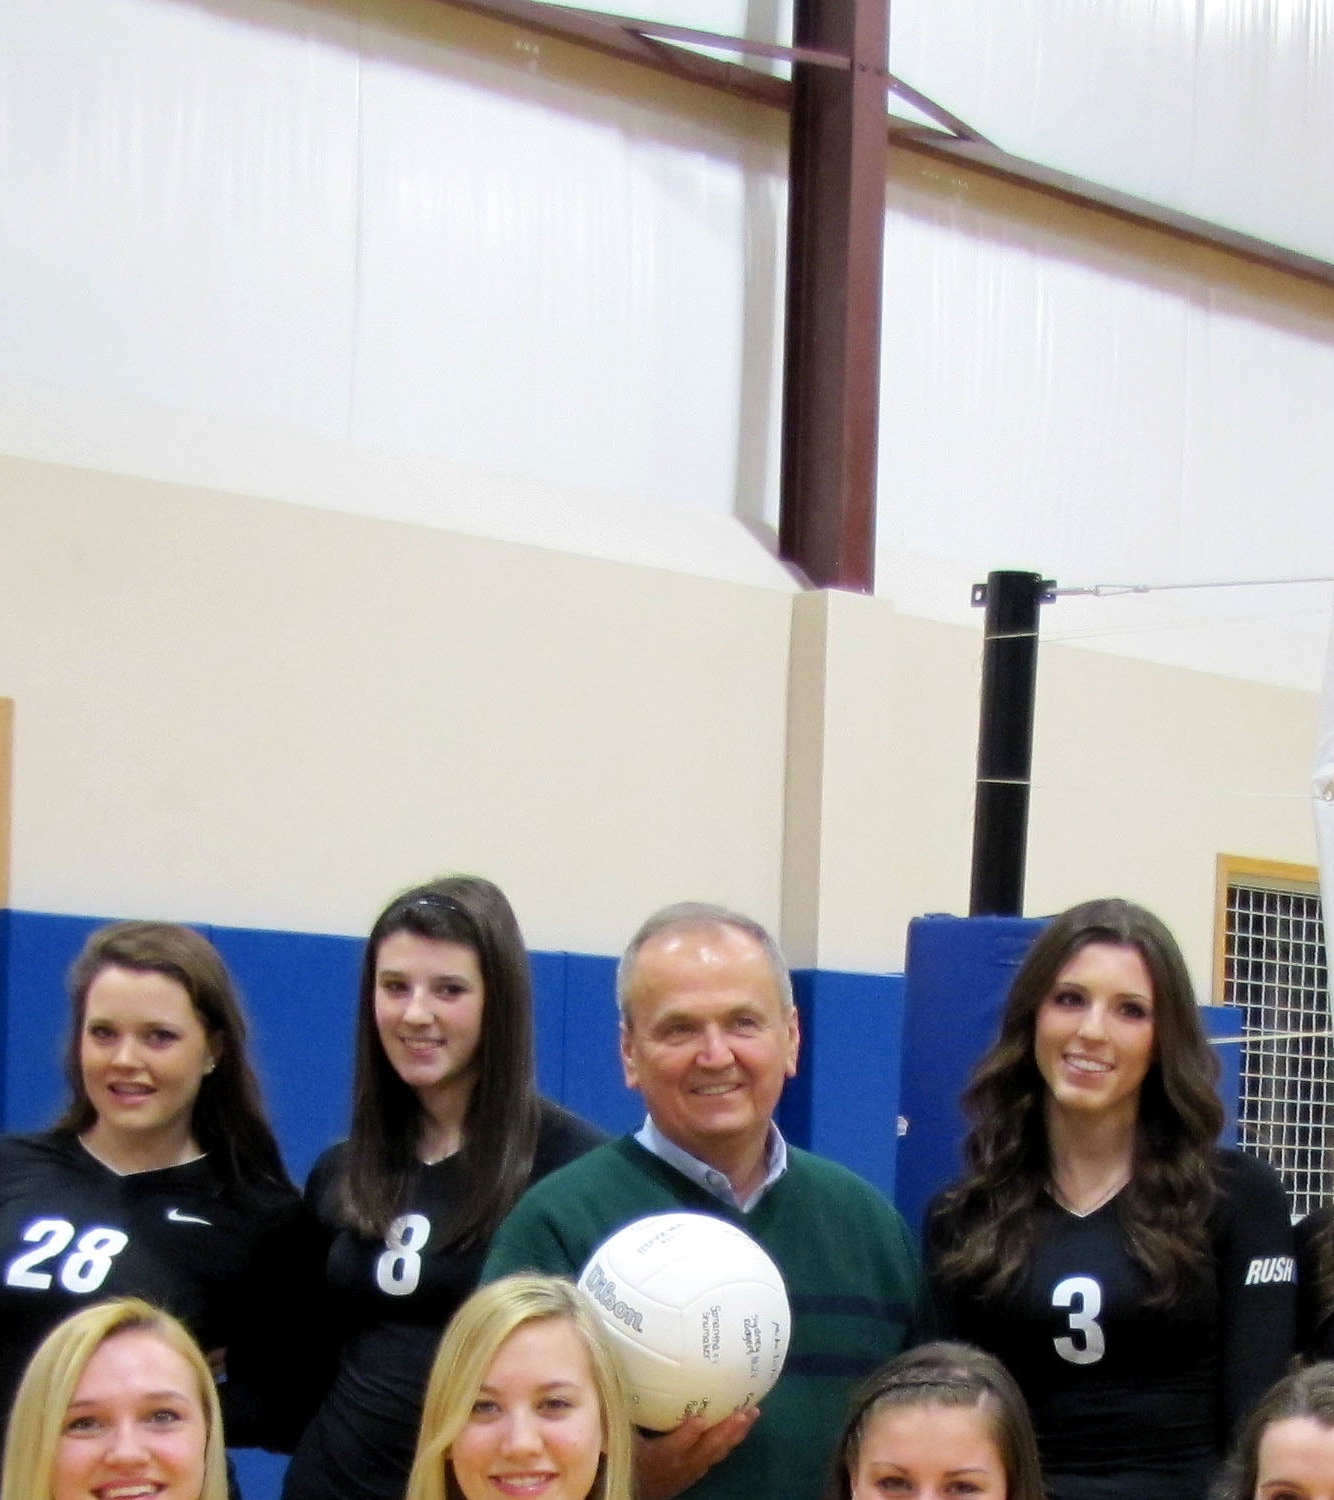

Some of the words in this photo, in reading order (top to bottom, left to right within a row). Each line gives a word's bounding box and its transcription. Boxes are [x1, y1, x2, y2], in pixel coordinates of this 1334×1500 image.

[6, 1219, 129, 1293] 28
[376, 1214, 431, 1296] 8
[1245, 1256, 1294, 1285] RUSH
[1052, 1276, 1106, 1365] 3
